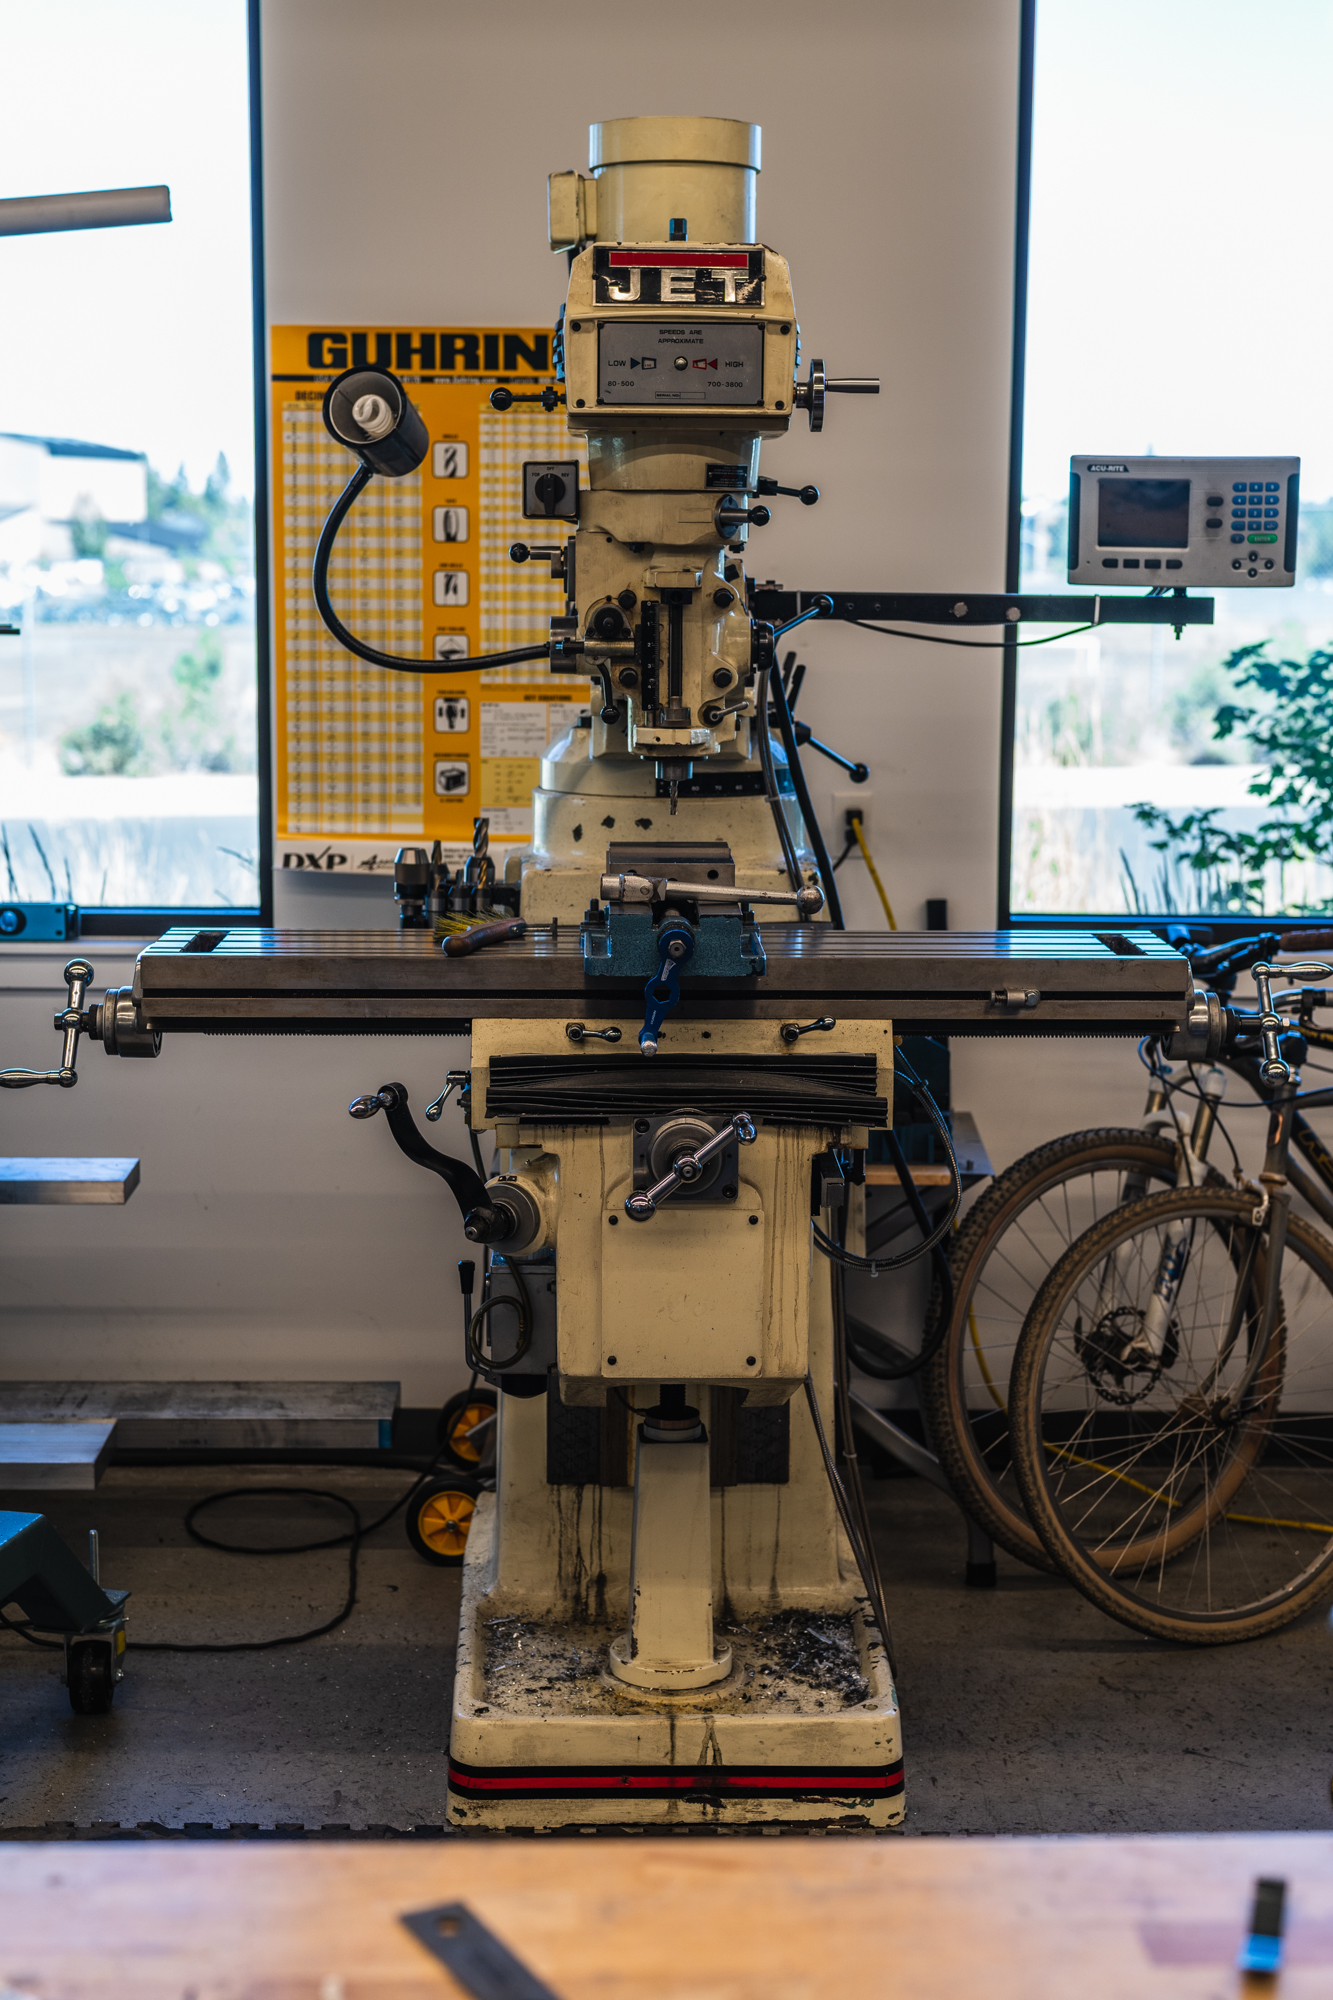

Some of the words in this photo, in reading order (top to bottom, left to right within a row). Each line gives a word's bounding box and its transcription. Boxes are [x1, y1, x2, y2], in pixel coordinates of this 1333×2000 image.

[608, 268, 749, 302] JET
[306, 332, 555, 370] GUHRIN
[282, 845, 347, 871] DXP
